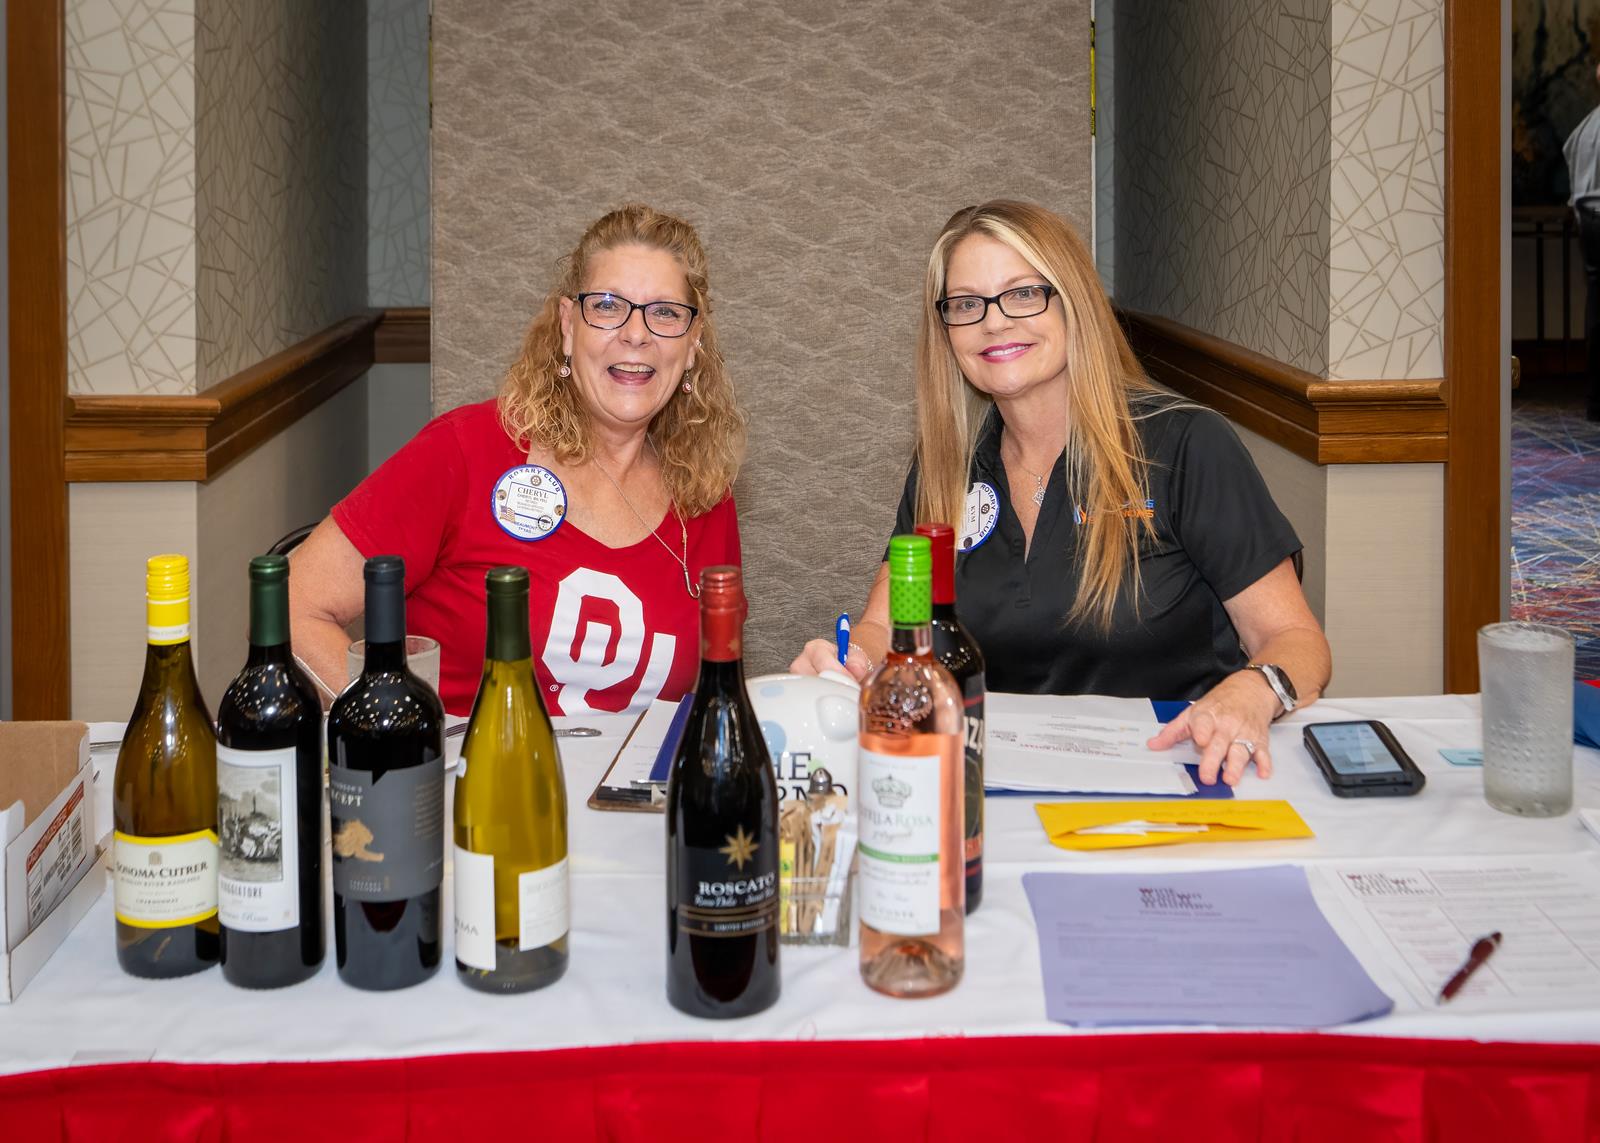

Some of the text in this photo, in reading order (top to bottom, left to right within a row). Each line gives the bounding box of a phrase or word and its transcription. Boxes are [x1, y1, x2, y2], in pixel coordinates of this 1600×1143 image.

[508, 468, 561, 492] ROTARY CLUB
[517, 487, 549, 499] CHERYL
[979, 484, 996, 538] ROTARY CLUB
[774, 752, 812, 781] HE
[698, 872, 776, 897] ROSCATO
